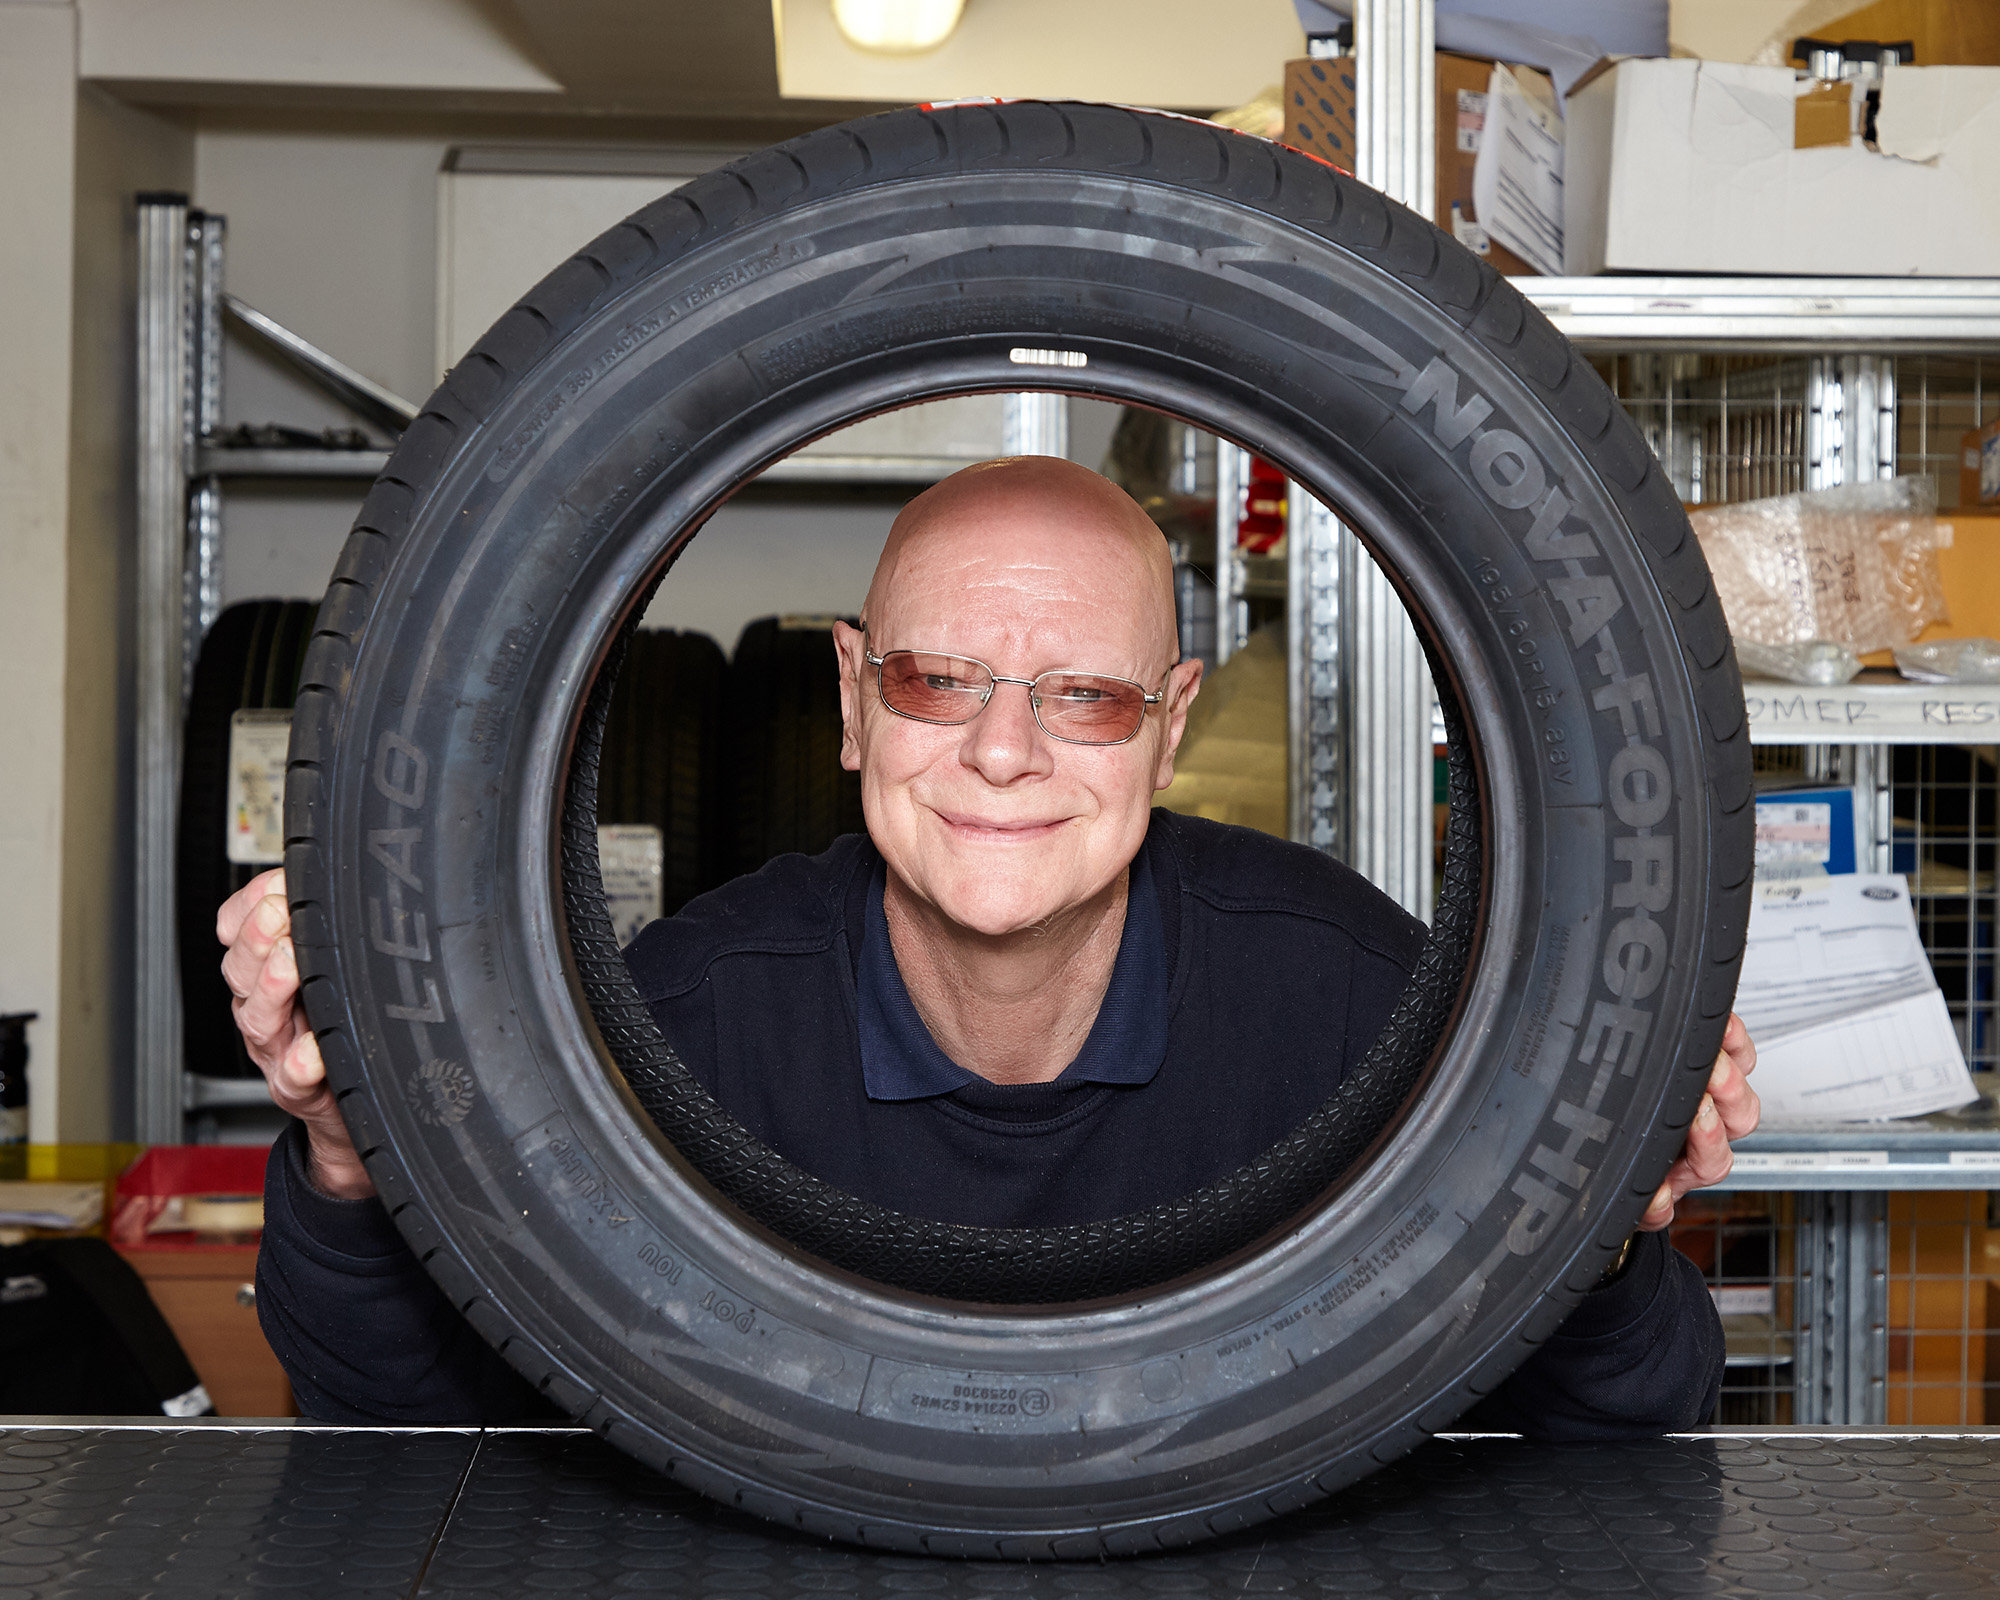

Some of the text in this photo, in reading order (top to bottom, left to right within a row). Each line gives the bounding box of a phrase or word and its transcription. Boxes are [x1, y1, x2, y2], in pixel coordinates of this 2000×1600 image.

[592, 314, 661, 370] TRACTION
[663, 304, 678, 320] A
[680, 250, 782, 309] TEMPERATURE
[788, 243, 803, 260] A
[1470, 553, 1571, 787] 195/60R15 88V
[690, 728, 771, 1025] LEAO
[1505, 1096, 1615, 1257] HP
[1396, 1206, 1442, 1252] SIDEWALL
[1401, 1200, 1434, 1233] TREAD
[638, 1243, 686, 1286] 10U
[1317, 1258, 1374, 1304] POLYESTER
[700, 1290, 756, 1334] DOT
[1315, 1272, 1373, 1317] POLYESTER
[1270, 1309, 1303, 1334] STEEL
[909, 1391, 1017, 1415] 023144 S2WR2
[952, 1384, 1017, 1400] 0259308
